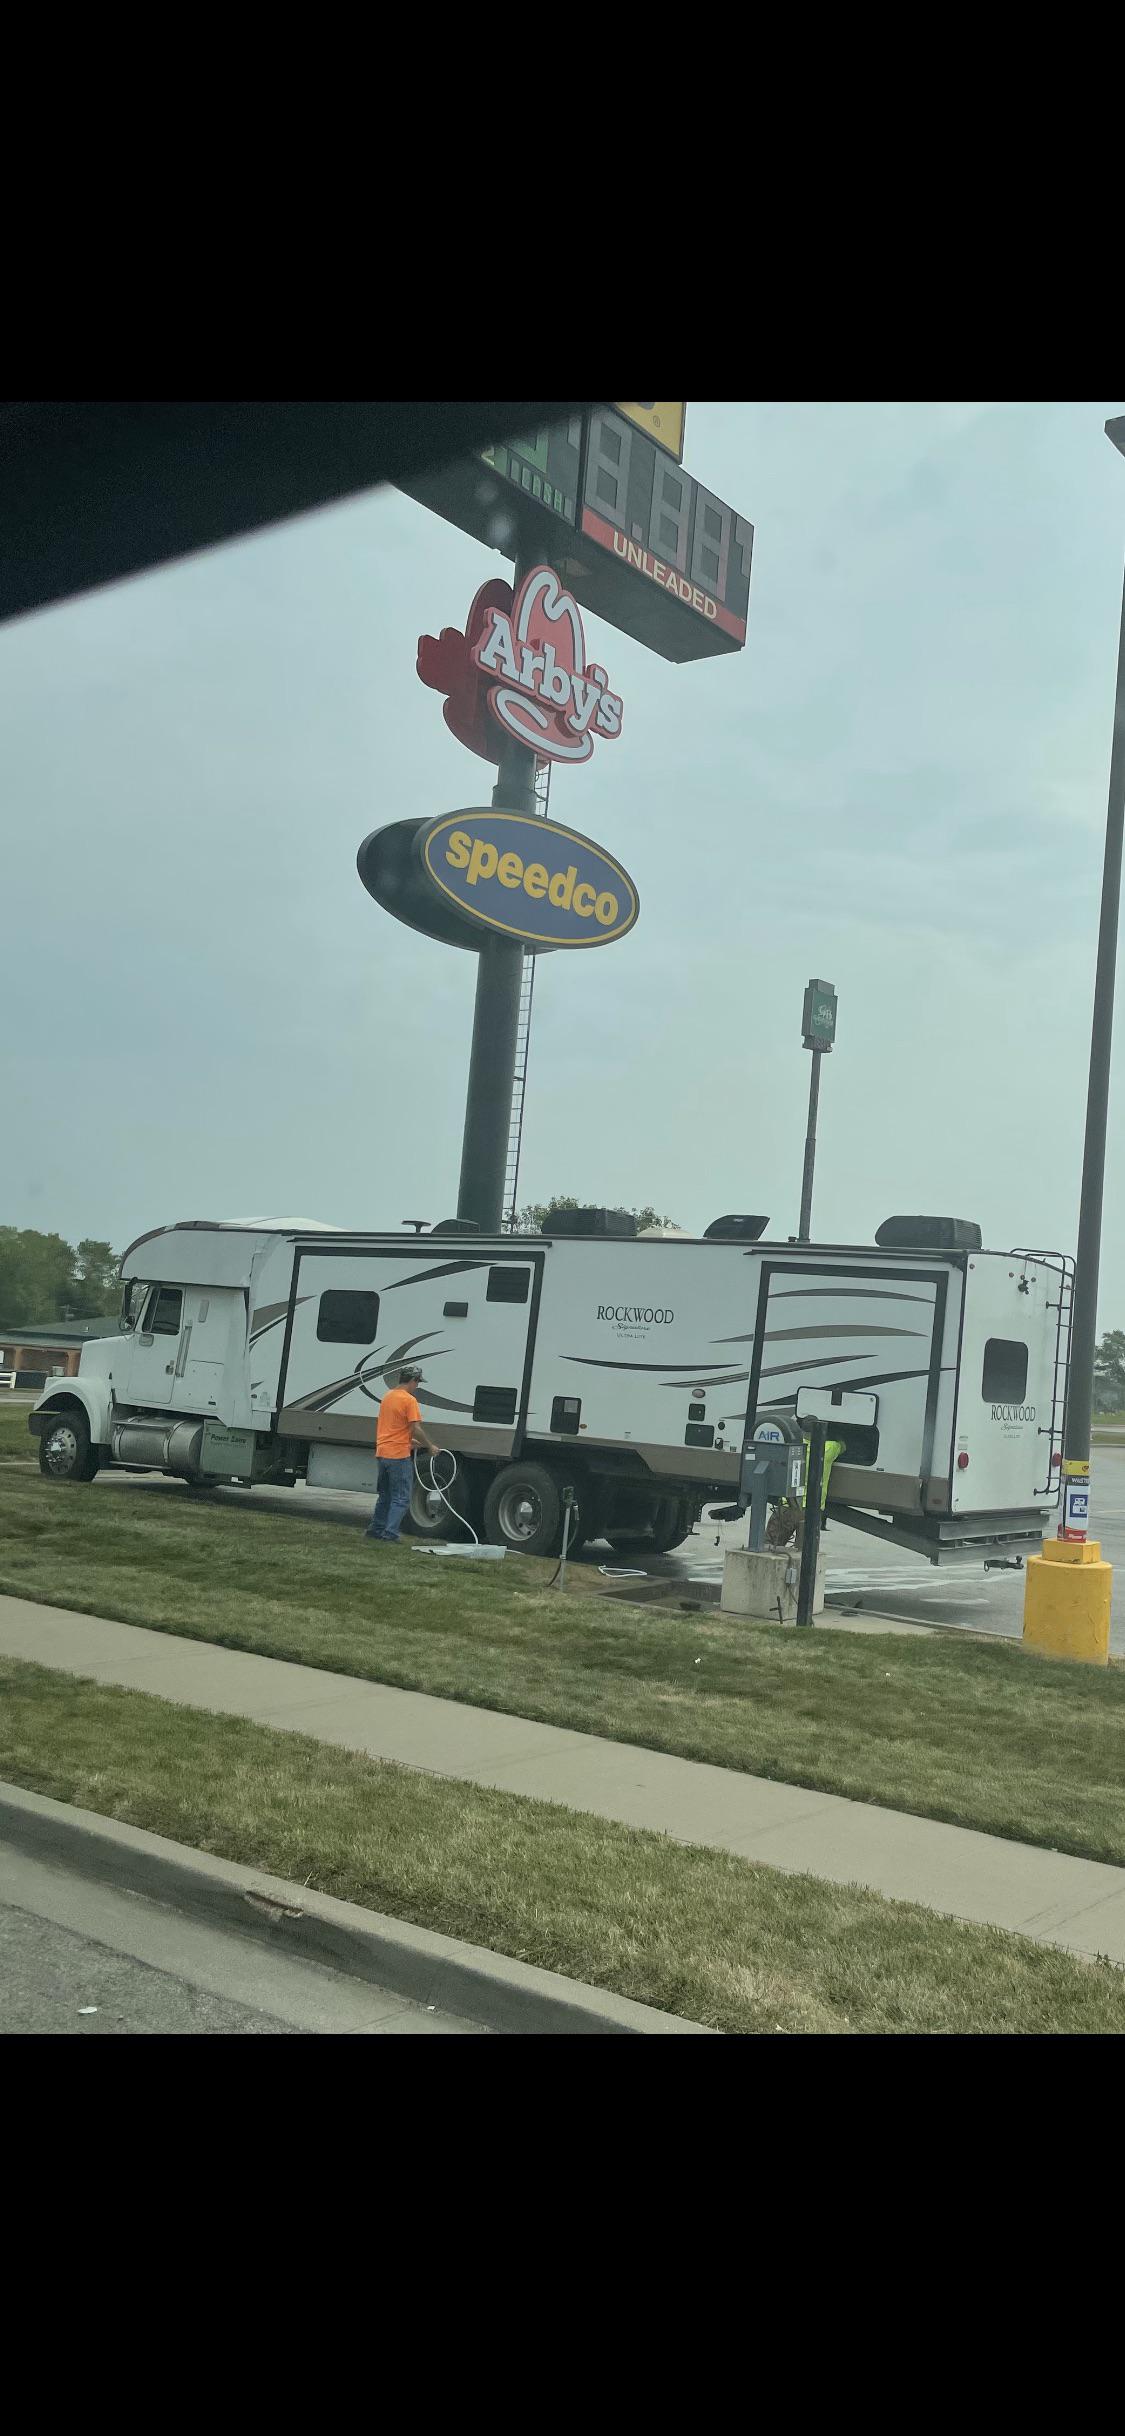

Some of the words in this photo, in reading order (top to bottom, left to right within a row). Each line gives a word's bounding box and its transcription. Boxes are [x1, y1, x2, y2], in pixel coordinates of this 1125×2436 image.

[613, 530, 717, 619] UNLEADED
[479, 612, 621, 733] Arby's
[445, 830, 619, 926] speedco
[596, 1305, 674, 1324] ROCKWOOD
[758, 1430, 780, 1441] AIR
[991, 1404, 1036, 1422] ROCKWOOD
